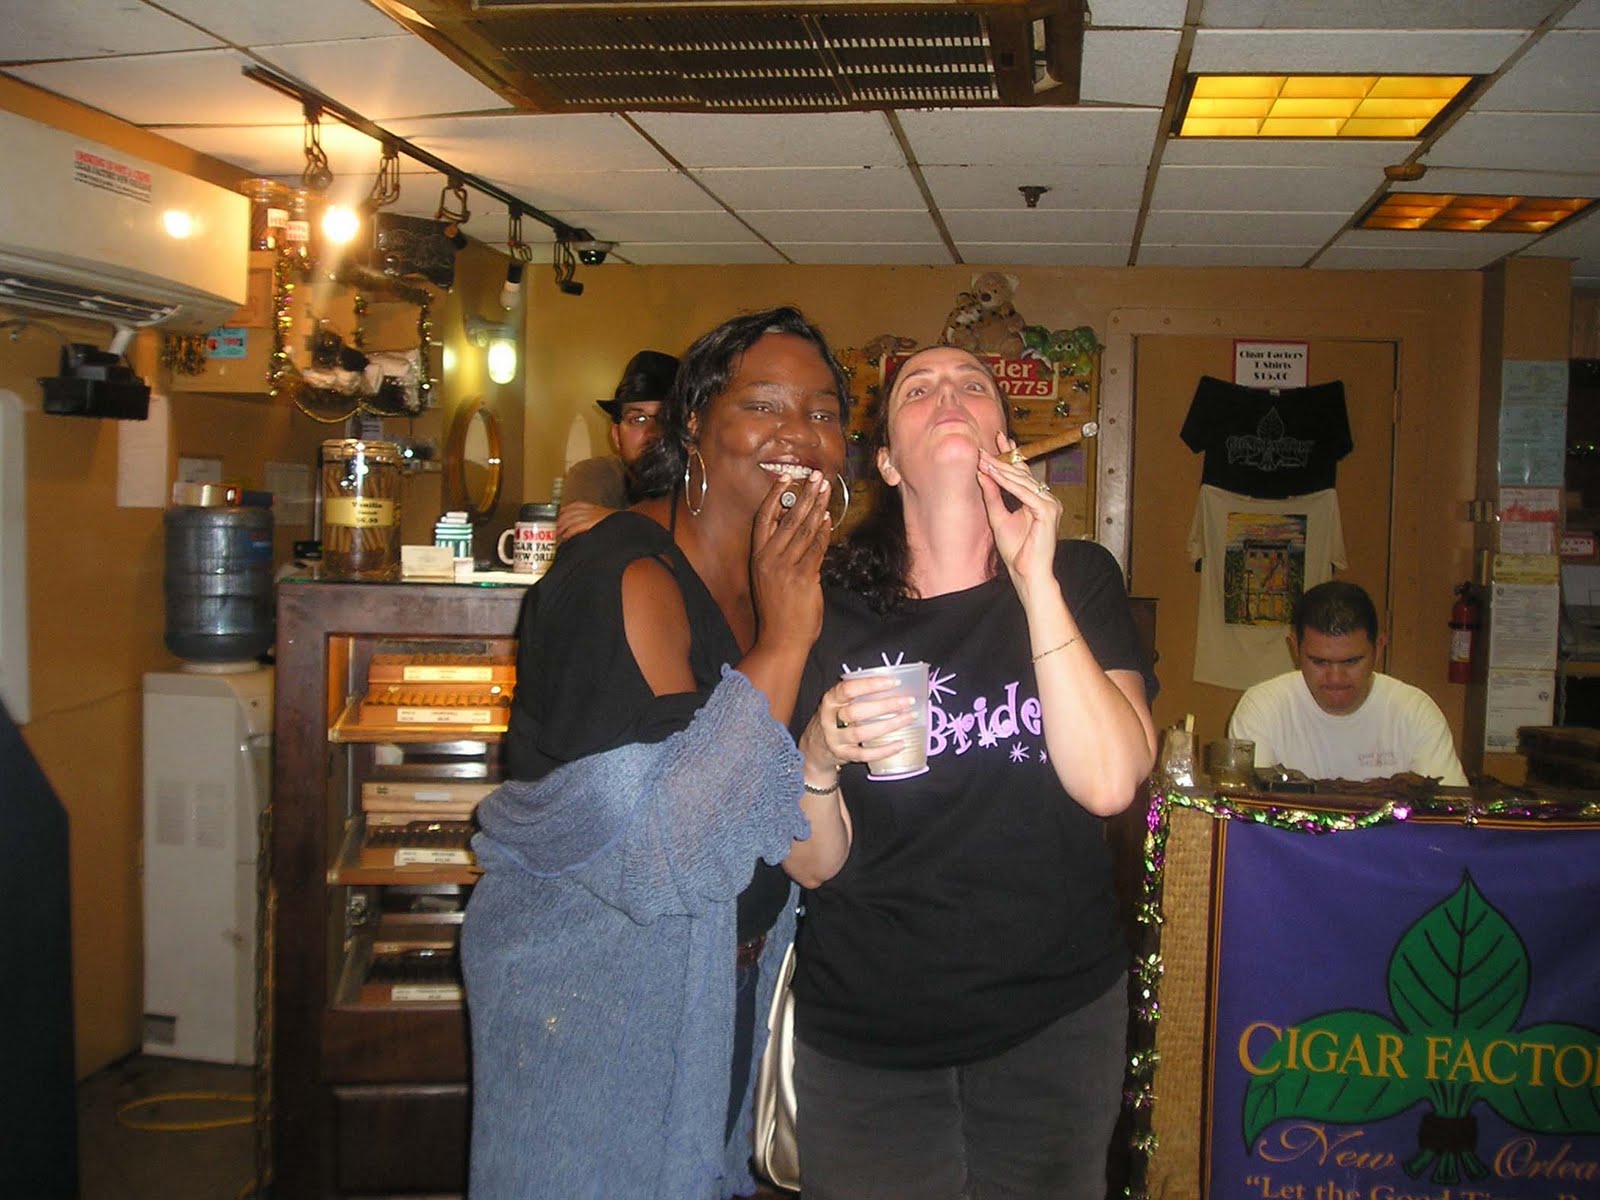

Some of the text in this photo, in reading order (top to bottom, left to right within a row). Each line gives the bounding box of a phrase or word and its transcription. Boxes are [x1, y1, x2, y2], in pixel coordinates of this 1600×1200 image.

[992, 359, 1033, 378] der
[1267, 350, 1303, 360] Factory
[926, 681, 1043, 757] Bride
[1238, 1022, 1408, 1079] CIGAR
[1259, 1122, 1395, 1169] New
